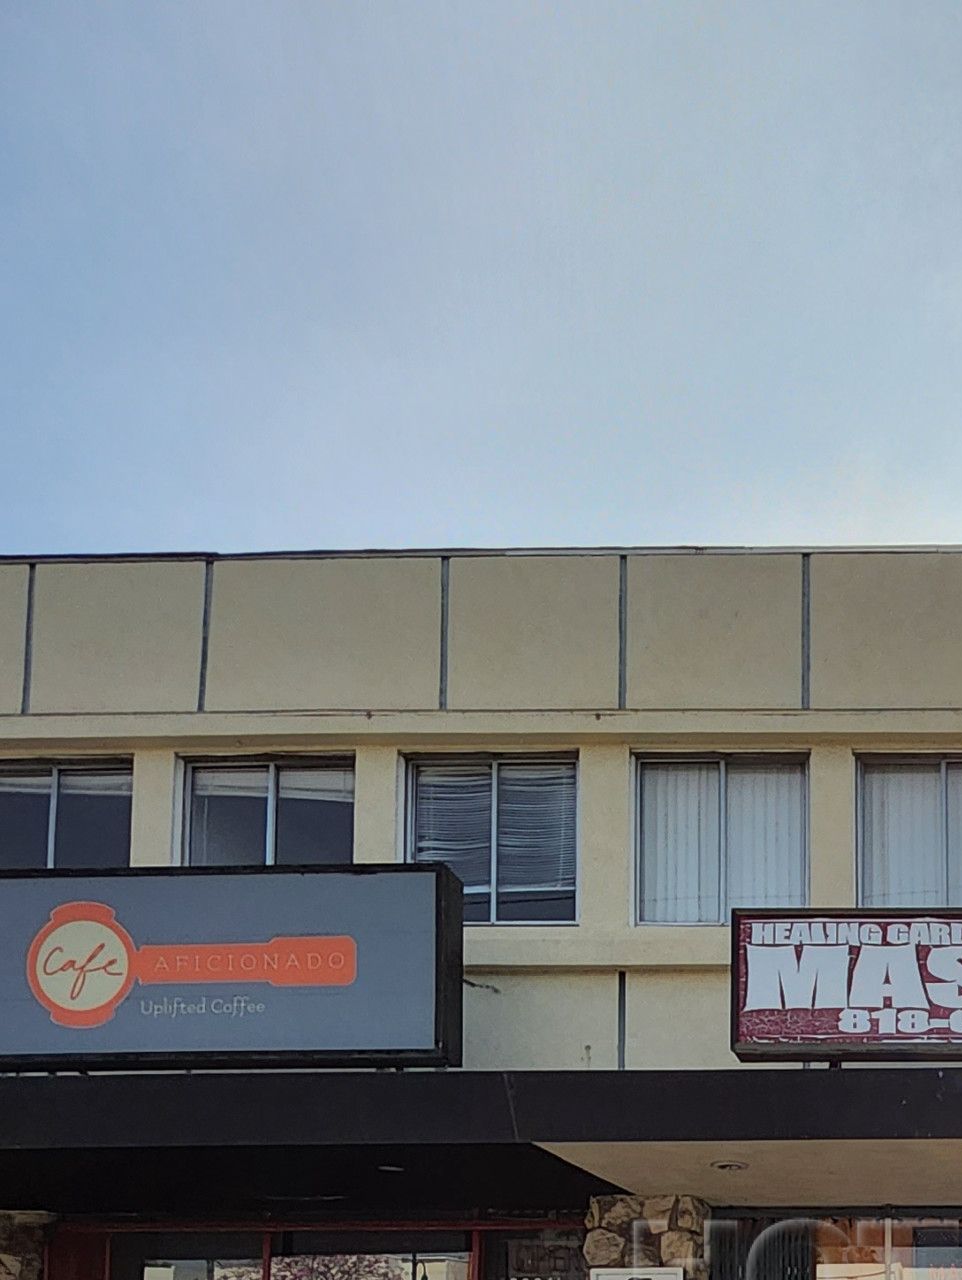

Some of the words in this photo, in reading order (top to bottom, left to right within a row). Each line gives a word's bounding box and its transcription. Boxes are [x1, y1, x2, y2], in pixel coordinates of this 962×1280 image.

[751, 921, 882, 945] HEALING
[43, 943, 123, 1000] Cafe
[154, 952, 345, 972] AFICIONADO
[140, 996, 206, 1018] Uplifted
[210, 995, 266, 1017] Coffee
